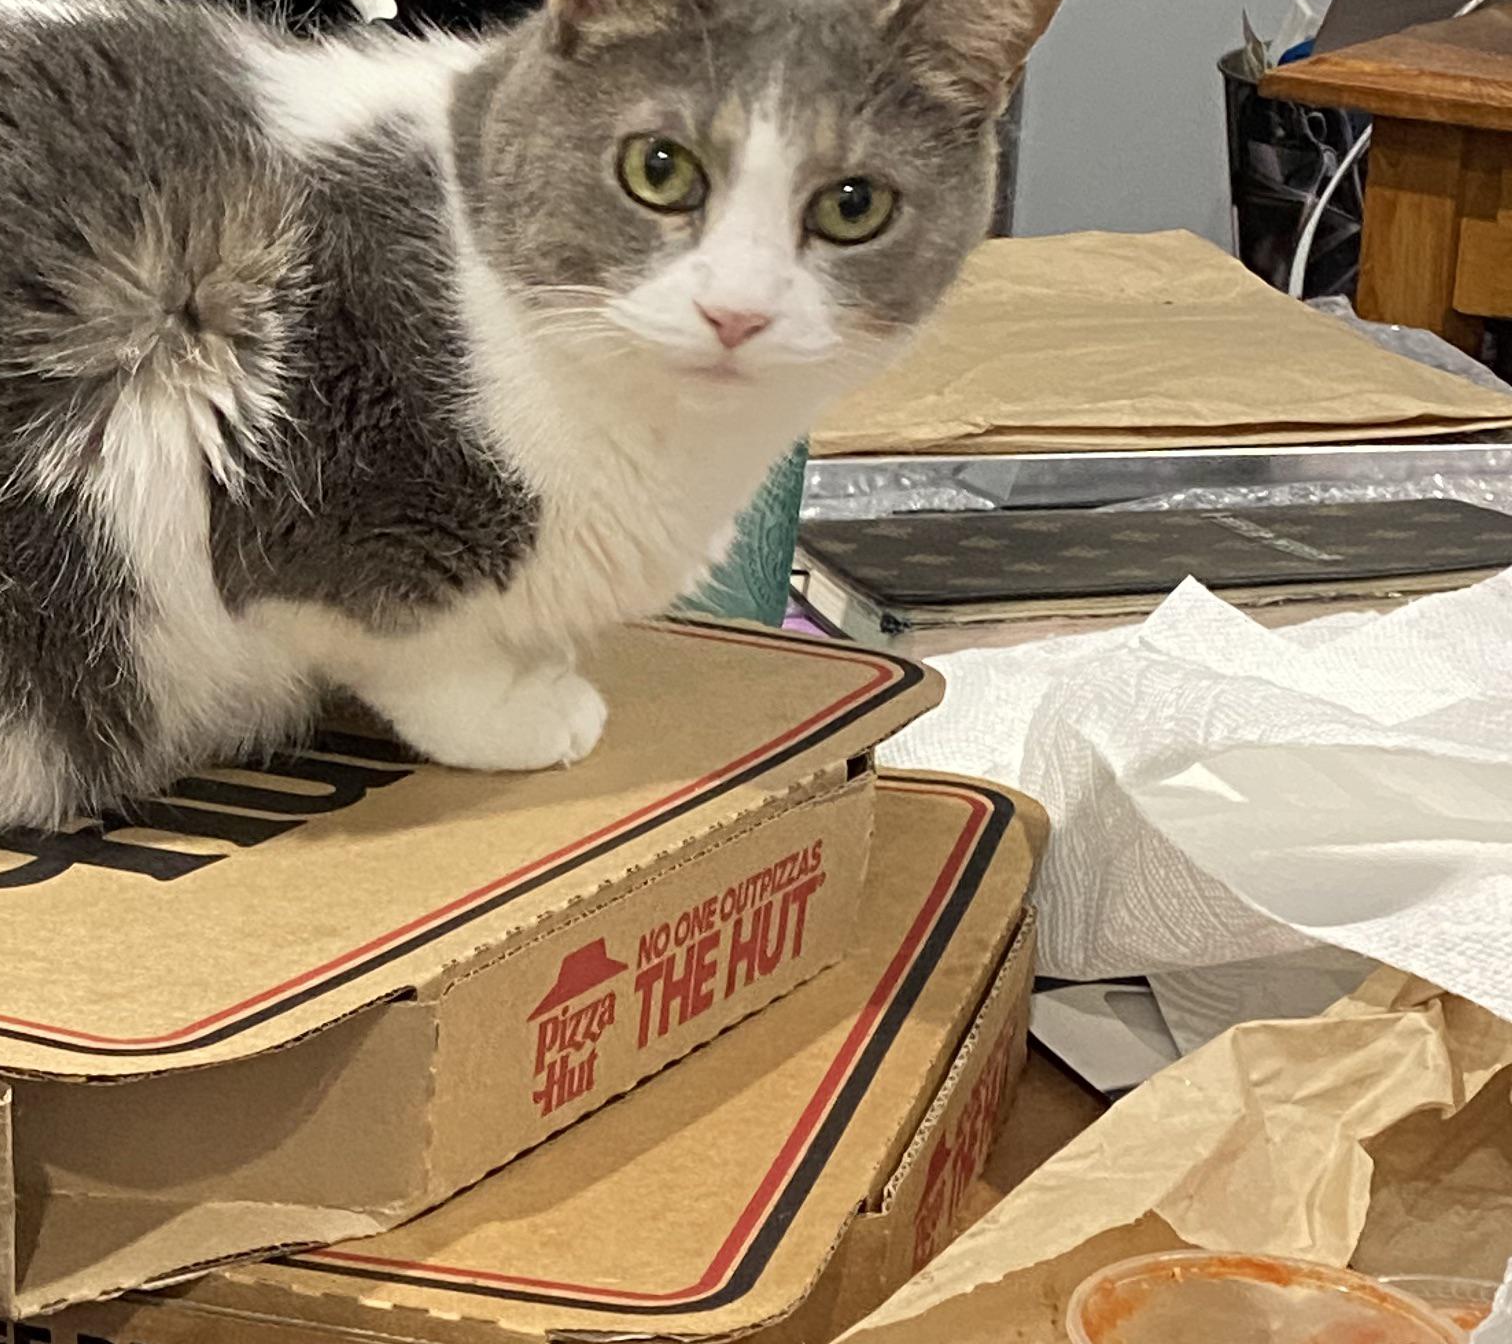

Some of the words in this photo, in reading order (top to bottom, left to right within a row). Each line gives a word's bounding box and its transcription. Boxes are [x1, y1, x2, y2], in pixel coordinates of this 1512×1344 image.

[636, 922, 672, 971] NO
[674, 895, 719, 948] ONE
[719, 837, 824, 922] OUTPIZZAS
[533, 989, 617, 1080] Pizza
[634, 928, 722, 1050] THE
[532, 1051, 599, 1118] Hut
